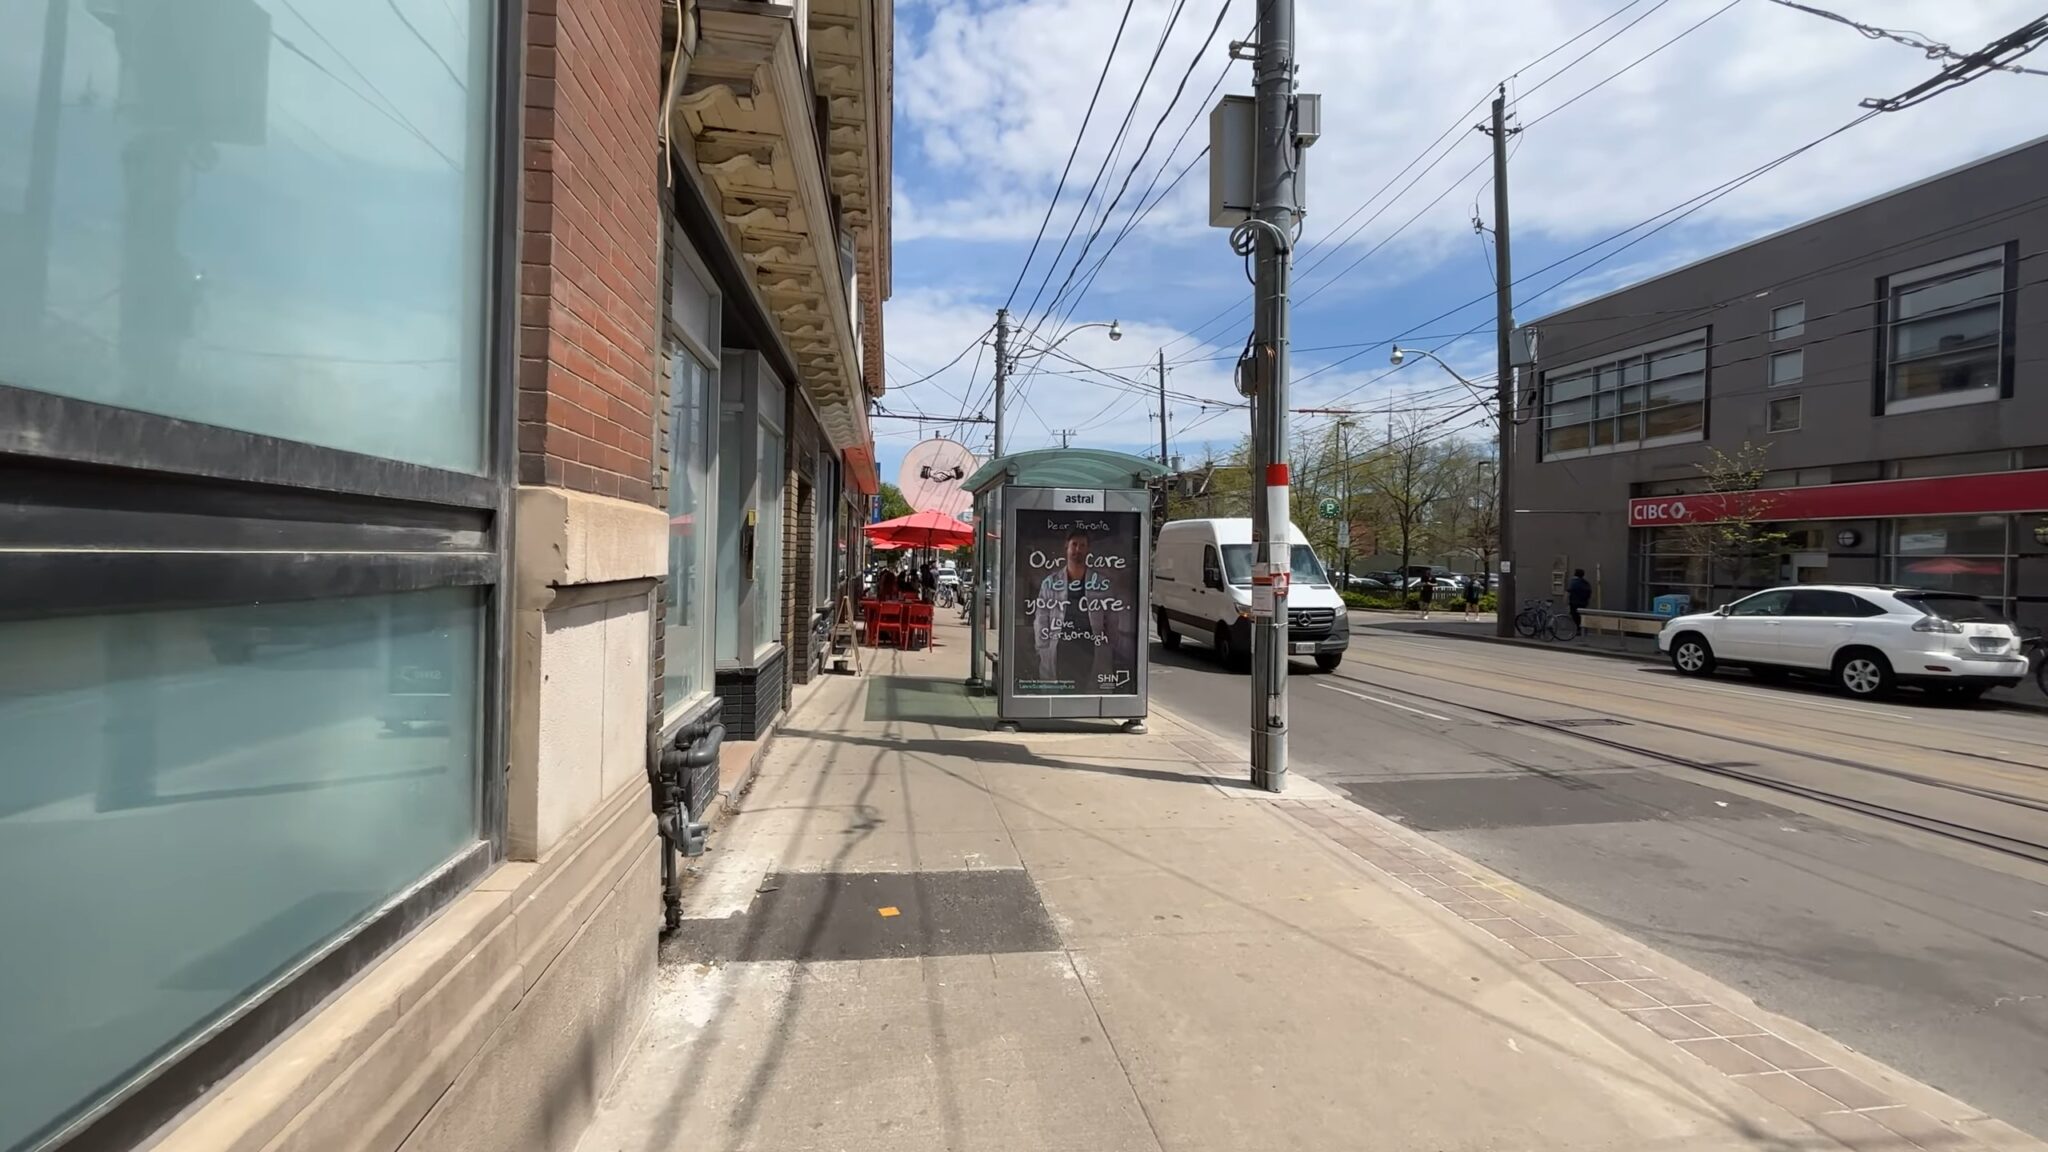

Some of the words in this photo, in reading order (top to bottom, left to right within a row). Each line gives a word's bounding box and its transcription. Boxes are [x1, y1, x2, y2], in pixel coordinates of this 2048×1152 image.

[1065, 494, 1094, 504] astral
[1634, 503, 1668, 520] CIBC
[1047, 519, 1070, 530] Dear
[1075, 520, 1110, 531] Toronto
[1029, 551, 1066, 569] Our
[1041, 572, 1111, 591] needs
[1025, 598, 1071, 615] your
[1097, 673, 1119, 683] SHN
